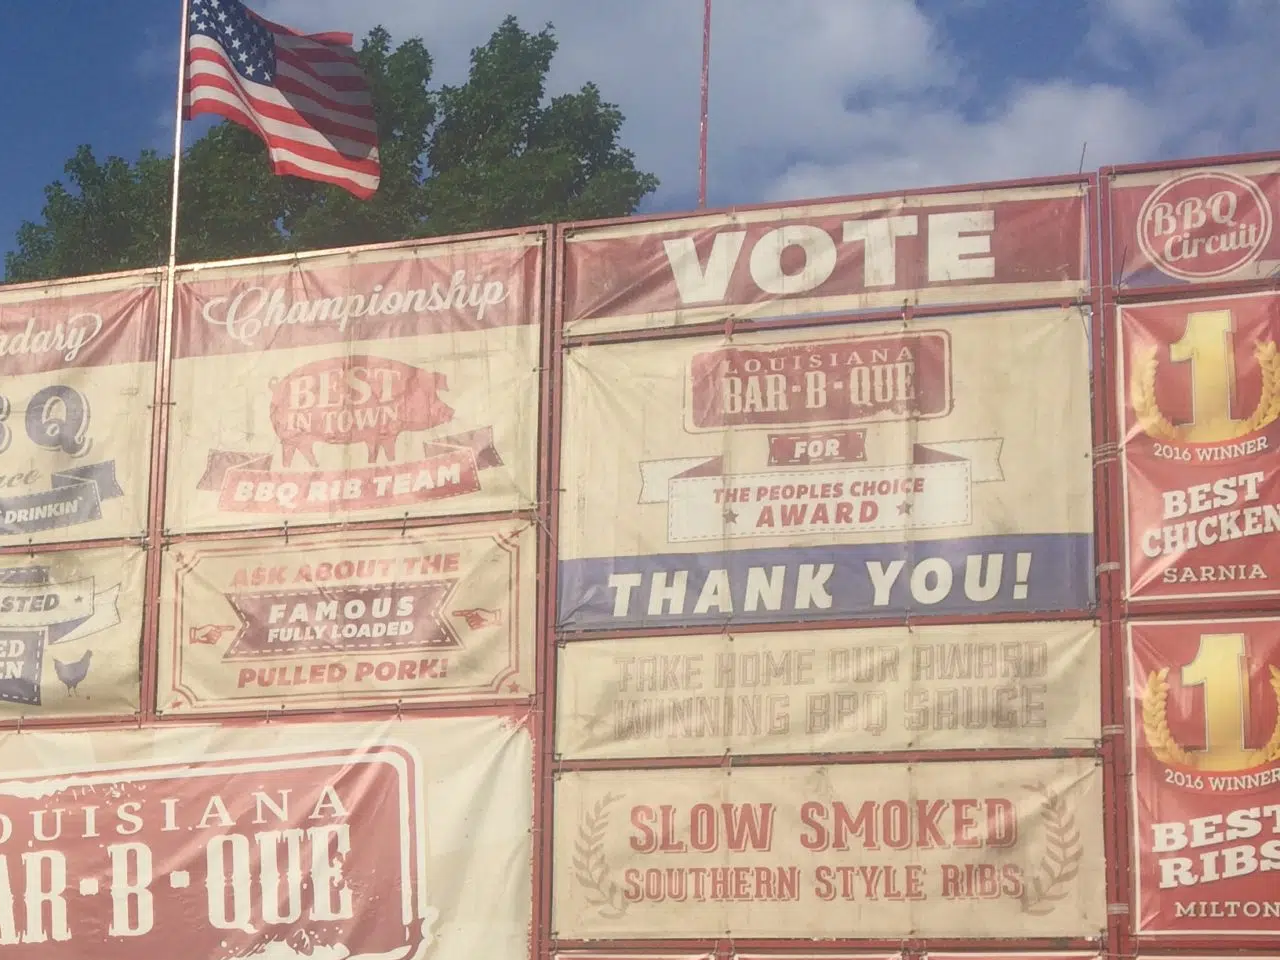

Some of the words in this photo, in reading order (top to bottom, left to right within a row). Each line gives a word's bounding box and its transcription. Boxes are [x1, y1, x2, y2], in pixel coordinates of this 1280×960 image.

[1149, 191, 1239, 237] BBQ
[664, 209, 995, 304] VOTE
[1163, 222, 1258, 262] Circuit
[202, 272, 512, 345] Championship
[289, 365, 397, 409] BEST
[793, 439, 841, 458] FOR
[1152, 442, 1192, 461] 2016
[1195, 436, 1268, 462] WINNER
[234, 479, 300, 508] BBQ
[309, 479, 364, 502] RIB
[373, 464, 462, 499] TEAM
[714, 484, 752, 503] THE
[756, 482, 845, 502] PEOPLES
[850, 477, 925, 497] CHOICE
[1163, 473, 1265, 521] BEST
[756, 501, 881, 527] AWARD
[228, 563, 288, 589] ASK
[292, 557, 400, 582] ABOUT
[408, 553, 460, 574] THE
[608, 564, 835, 617] THANK
[866, 552, 1034, 605] YOU!
[1163, 566, 1267, 583] SARNIA
[267, 596, 415, 624] FAMOUS
[268, 626, 336, 642] FULLY
[339, 621, 414, 639] LOADED
[629, 803, 777, 854] SLOW
[799, 798, 1018, 852] SMOKED
[624, 867, 800, 902] SOUTHERN
[815, 864, 927, 902] STYLE
[940, 862, 1025, 899] RIBS
